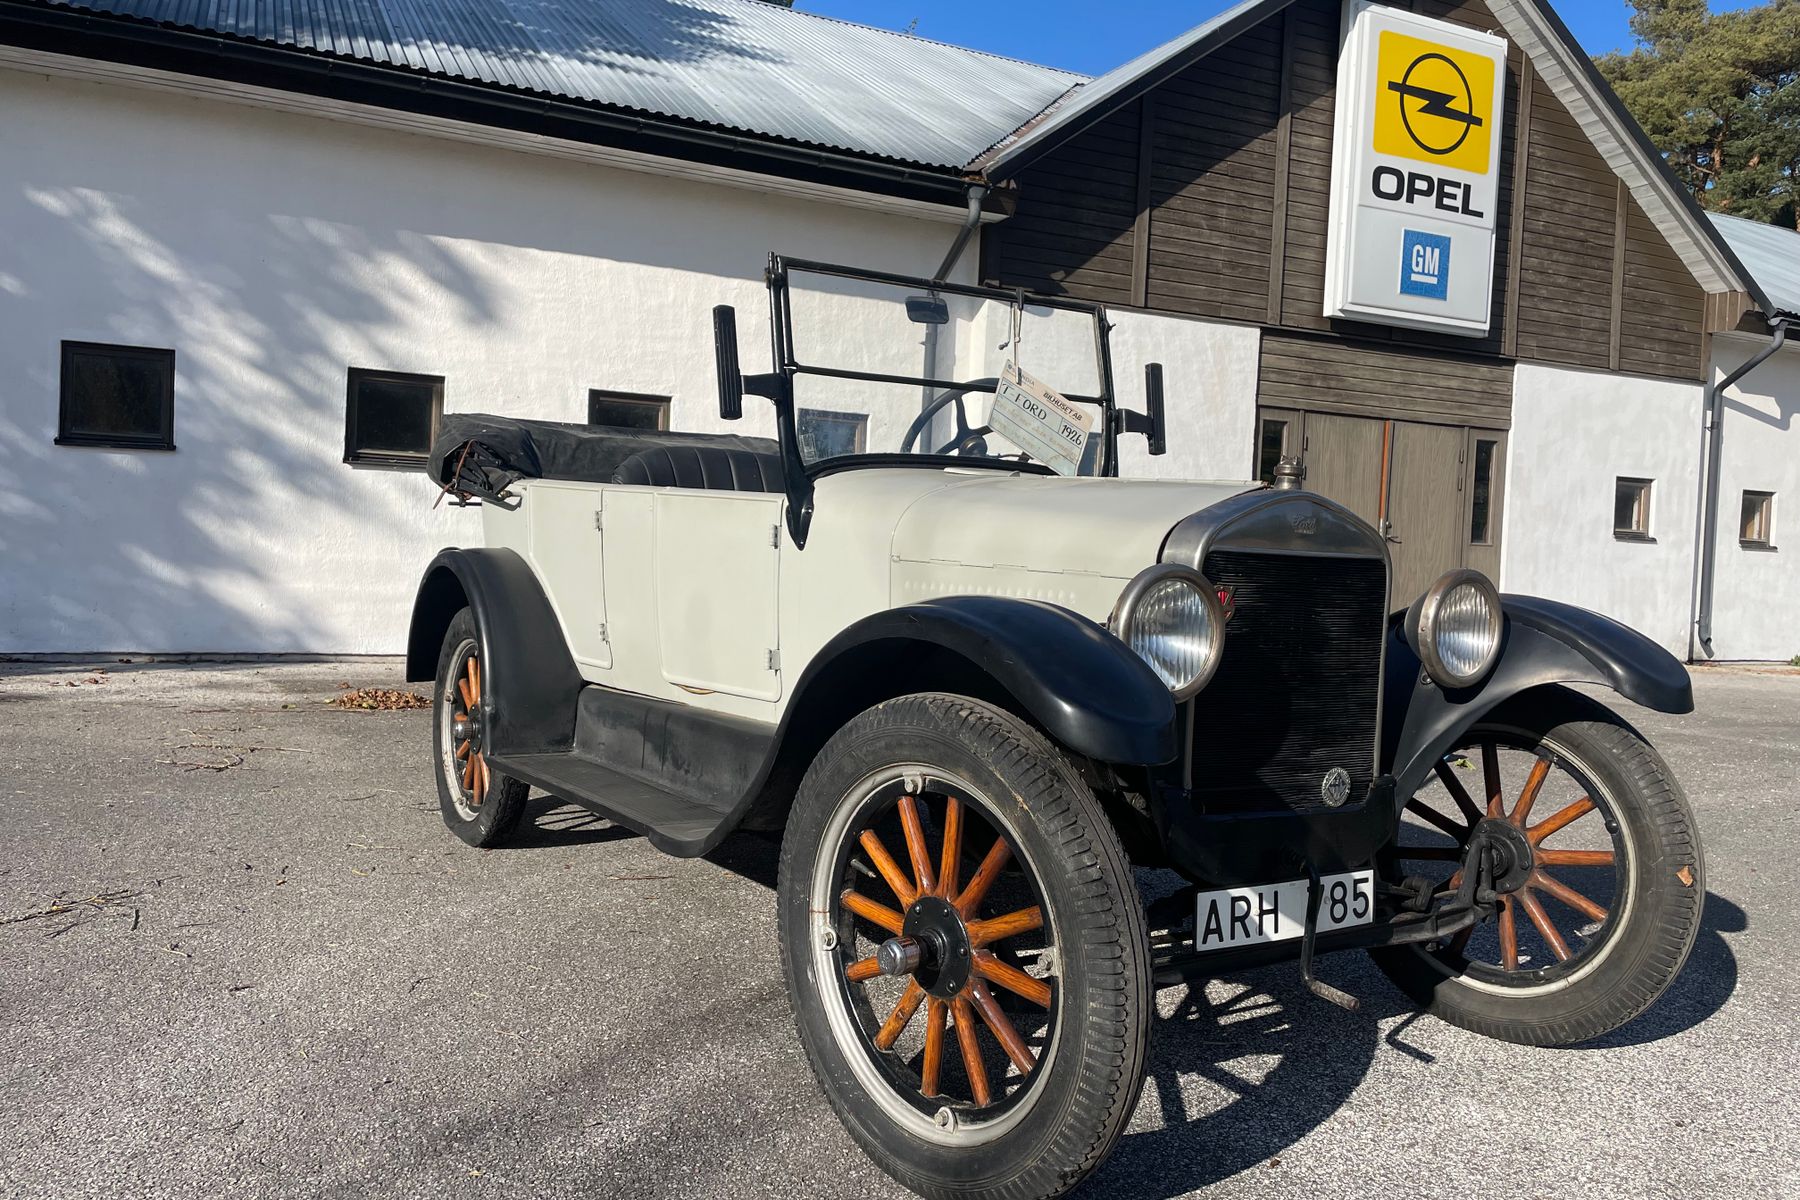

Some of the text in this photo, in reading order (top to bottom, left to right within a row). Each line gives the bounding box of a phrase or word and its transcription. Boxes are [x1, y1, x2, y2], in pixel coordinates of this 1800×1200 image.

[1372, 165, 1484, 218] OPEL
[1411, 244, 1440, 275] GM
[1042, 390, 1073, 416] BILHUSET
[1072, 411, 1083, 422] AB
[1061, 424, 1082, 446] 1926
[1202, 890, 1279, 945] ARH
